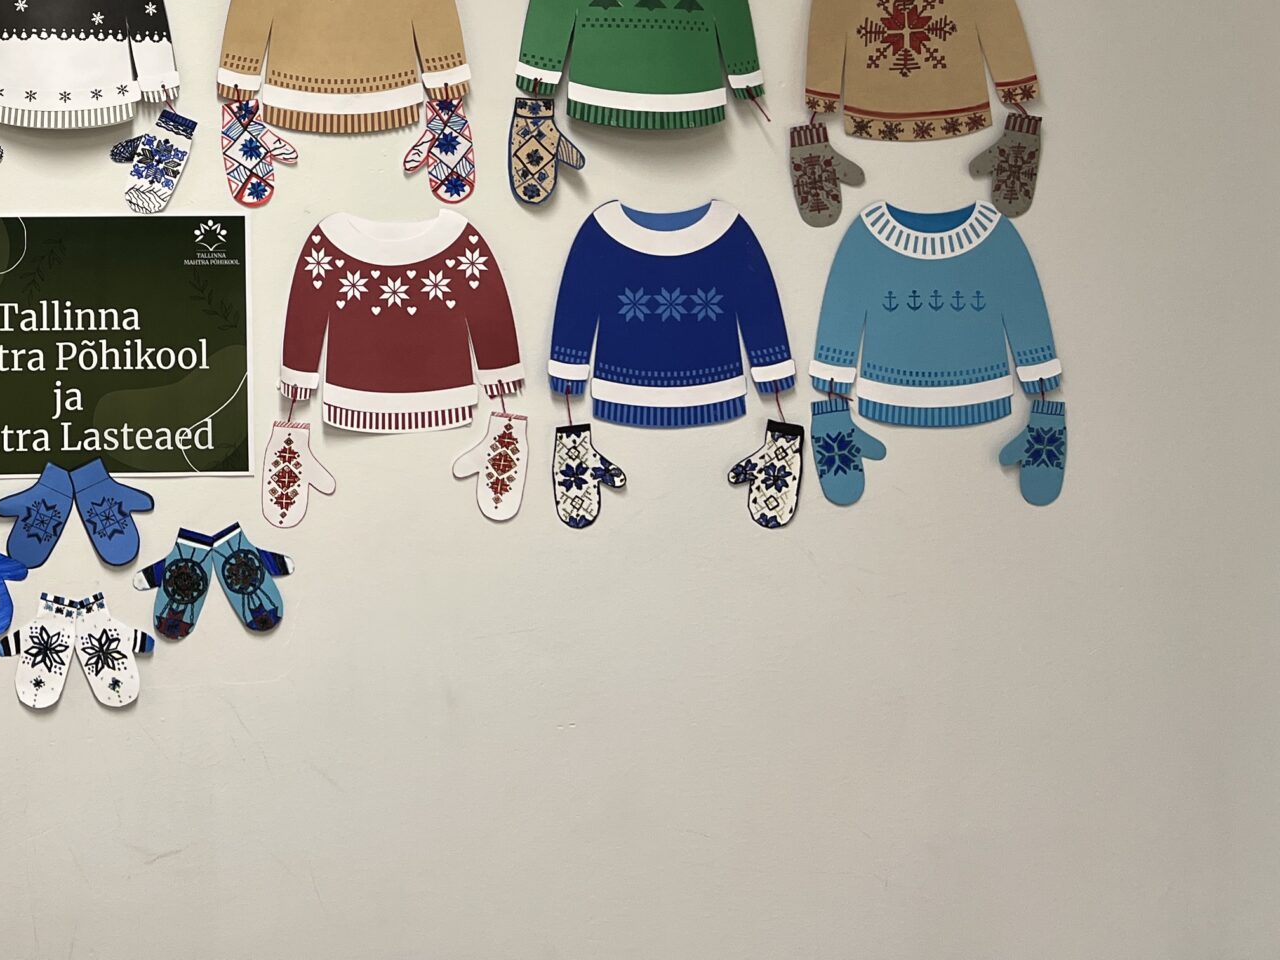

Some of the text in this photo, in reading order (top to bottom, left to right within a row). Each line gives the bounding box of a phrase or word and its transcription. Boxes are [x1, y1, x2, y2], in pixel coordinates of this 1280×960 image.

[55, 338, 210, 371] Põhikool
[52, 380, 84, 419] ja
[60, 417, 215, 452] Lasteaed
